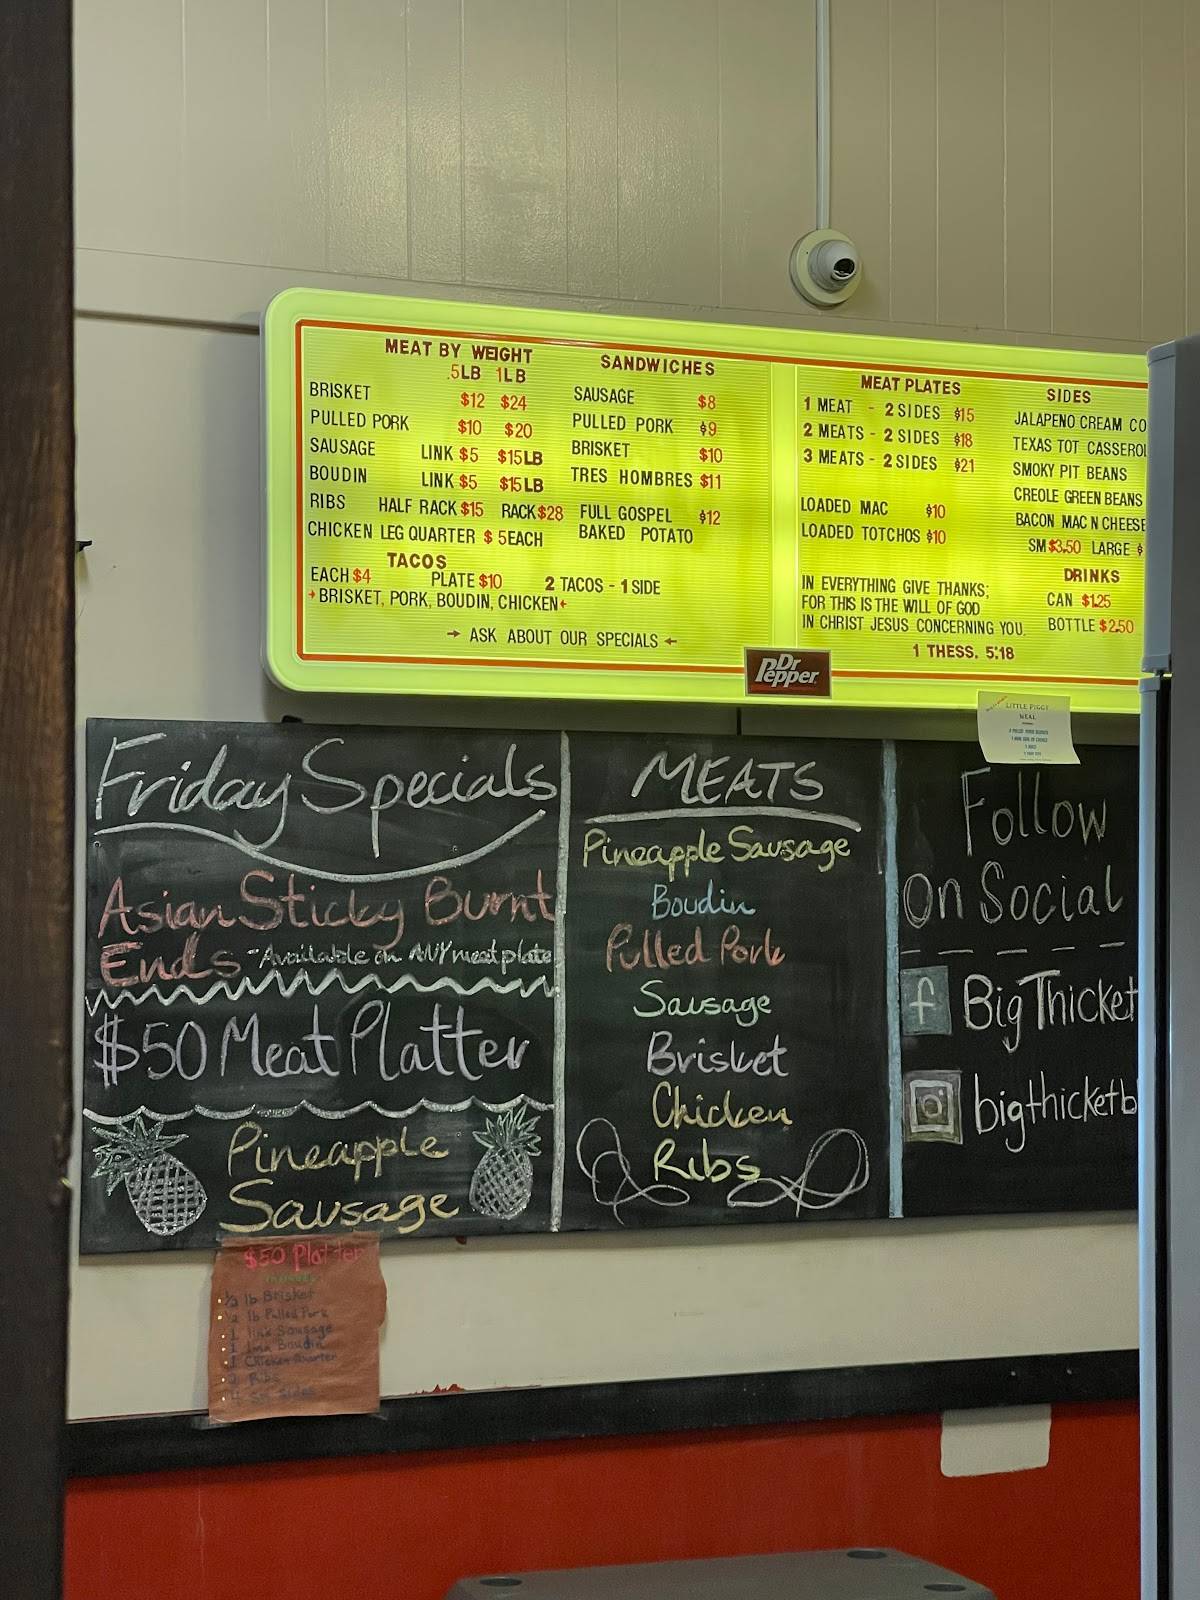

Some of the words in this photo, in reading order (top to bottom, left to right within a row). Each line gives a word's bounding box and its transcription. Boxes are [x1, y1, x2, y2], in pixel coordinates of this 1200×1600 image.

[386, 339, 432, 356] MEAT
[440, 343, 461, 358] BY
[472, 345, 532, 363] WEIGHT
[496, 367, 526, 383] 1LB
[601, 355, 714, 376] SANDWICHES
[310, 382, 371, 400] BRISKET
[461, 392, 485, 408] $12
[500, 395, 527, 411] $24
[861, 375, 900, 391] MEAT
[905, 379, 961, 395] PLATES
[1048, 389, 1091, 403] SIDES
[574, 386, 634, 404] SAUSAGE
[698, 394, 716, 409] $8
[818, 398, 852, 413] MEAT
[885, 403, 893, 416] 2
[898, 403, 940, 420] SIDES
[955, 407, 974, 422] $15
[1015, 412, 1075, 428] JALAPENO
[1080, 416, 1122, 431] CREAM
[311, 410, 366, 428] PULLED
[373, 414, 409, 431] PORK
[458, 419, 481, 435] $10
[505, 422, 532, 438] $20
[573, 413, 626, 430] PULLED
[636, 417, 673, 433] PORK
[700, 422, 716, 436] $9
[803, 423, 812, 436] 2
[819, 424, 864, 440] MEATS
[884, 428, 893, 442] 2
[898, 429, 939, 445] SIDES
[954, 433, 972, 447] $18
[310, 438, 375, 456] SAUSAGE
[422, 445, 453, 461] LINK
[460, 447, 478, 462] $5
[572, 440, 630, 457] BRISKET
[699, 448, 722, 463] $10
[1013, 437, 1052, 452] TEXAS
[1058, 440, 1079, 453] TOT
[804, 448, 812, 463] 3
[819, 449, 864, 466] MEATS
[884, 454, 892, 467] 2
[896, 455, 937, 470] SIDES
[955, 458, 974, 472] $21
[1013, 462, 1054, 477] SMOKY
[1060, 465, 1080, 478] PIT
[1087, 466, 1127, 481] BEANS
[310, 466, 367, 483] BOUDIN
[422, 472, 454, 489] LINK
[459, 474, 477, 490] $5
[571, 467, 607, 483] TRES
[620, 469, 693, 487] HOMBRES
[700, 474, 721, 489] $11
[310, 493, 345, 509] RIBS
[379, 497, 412, 513] HALF
[420, 500, 457, 516] RACK
[461, 501, 483, 517] $15
[502, 504, 535, 520] RACK
[538, 505, 563, 521] $28
[801, 497, 850, 513] LOADED
[861, 501, 888, 516] MAC
[927, 504, 945, 518] $10
[1014, 487, 1058, 502] CREOLE
[1065, 490, 1101, 504] GREEN
[1105, 492, 1142, 506] BEANS
[580, 504, 611, 520] FULL
[618, 506, 672, 523] GOSPEL
[700, 510, 720, 525] $12
[1016, 513, 1054, 527] BACON
[1062, 515, 1087, 529] MAC
[308, 521, 372, 539] CHICKEN
[381, 525, 403, 540] LEG
[409, 526, 475, 544] QUARTER
[579, 524, 625, 540] BAKED
[641, 527, 693, 543] POTATO
[802, 523, 853, 539] LOADED
[862, 526, 920, 543] TOTCHOS
[927, 529, 946, 544] $10
[1029, 539, 1046, 552] SM
[1049, 539, 1080, 554] $3.50
[1092, 541, 1130, 555] LARGE
[387, 552, 447, 569] TACOS
[311, 567, 348, 582] EACH
[353, 568, 371, 583] $4
[432, 572, 474, 588] PLATE
[479, 573, 502, 589] $10
[561, 577, 603, 593] TACOS
[632, 579, 660, 595] SIDE
[802, 575, 814, 590] IN
[822, 576, 896, 593] EVERYTHING
[903, 580, 930, 595] GIVE
[1064, 568, 1120, 583] DRINKS
[320, 589, 385, 607] BRISKET,
[390, 591, 432, 608] PORK,
[437, 593, 493, 610] BOUDIN,
[498, 595, 558, 611] CHICKEN
[802, 596, 825, 610] FOR
[830, 596, 856, 611] THIS
[861, 597, 872, 611] IS
[876, 598, 898, 612] THE
[903, 599, 931, 614] WILL
[937, 600, 952, 615] OF
[957, 601, 980, 615] GOD
[1047, 592, 1072, 607] CAN
[1082, 594, 1111, 608] $1.25
[802, 614, 814, 628] IN
[820, 615, 864, 630] CHRIST
[870, 617, 909, 632] JESUS
[917, 619, 994, 635] CONCERNING
[1048, 617, 1095, 631] BOTTLE
[1100, 619, 1133, 633] $2.50
[470, 628, 496, 643] ASK
[508, 629, 552, 644] ABOUT
[560, 631, 587, 646] OUR
[597, 632, 658, 648] SPECIALS
[776, 654, 801, 670] Dr
[927, 645, 978, 658] THESS.
[755, 658, 819, 687] Pepper
[631, 752, 823, 804] MEATS
[94, 733, 291, 851] Friday
[300, 737, 558, 858] Specials
[961, 767, 1106, 857] Follow
[583, 828, 725, 882] Pineapple
[728, 825, 850, 872] Sausage
[652, 879, 756, 920] Boudin
[903, 873, 963, 928] On
[980, 860, 1123, 925] Social
[98, 876, 236, 939] Asian
[239, 869, 406, 949] Sticky
[425, 869, 555, 926] Burnt
[606, 923, 711, 972] Pulled
[721, 925, 786, 966] Pork
[100, 932, 242, 987] Ends
[633, 979, 771, 1027] Sausage
[93, 1013, 208, 1090] $50
[221, 1003, 340, 1077] Meat
[351, 1000, 530, 1081] Platter
[647, 1030, 789, 1077] Brisket
[652, 1081, 793, 1129] Chicken
[227, 1122, 450, 1183] Pineapple
[654, 1137, 761, 1183] Ribs
[220, 1178, 460, 1232] Sausage
[263, 1288, 314, 1301] Brisket
